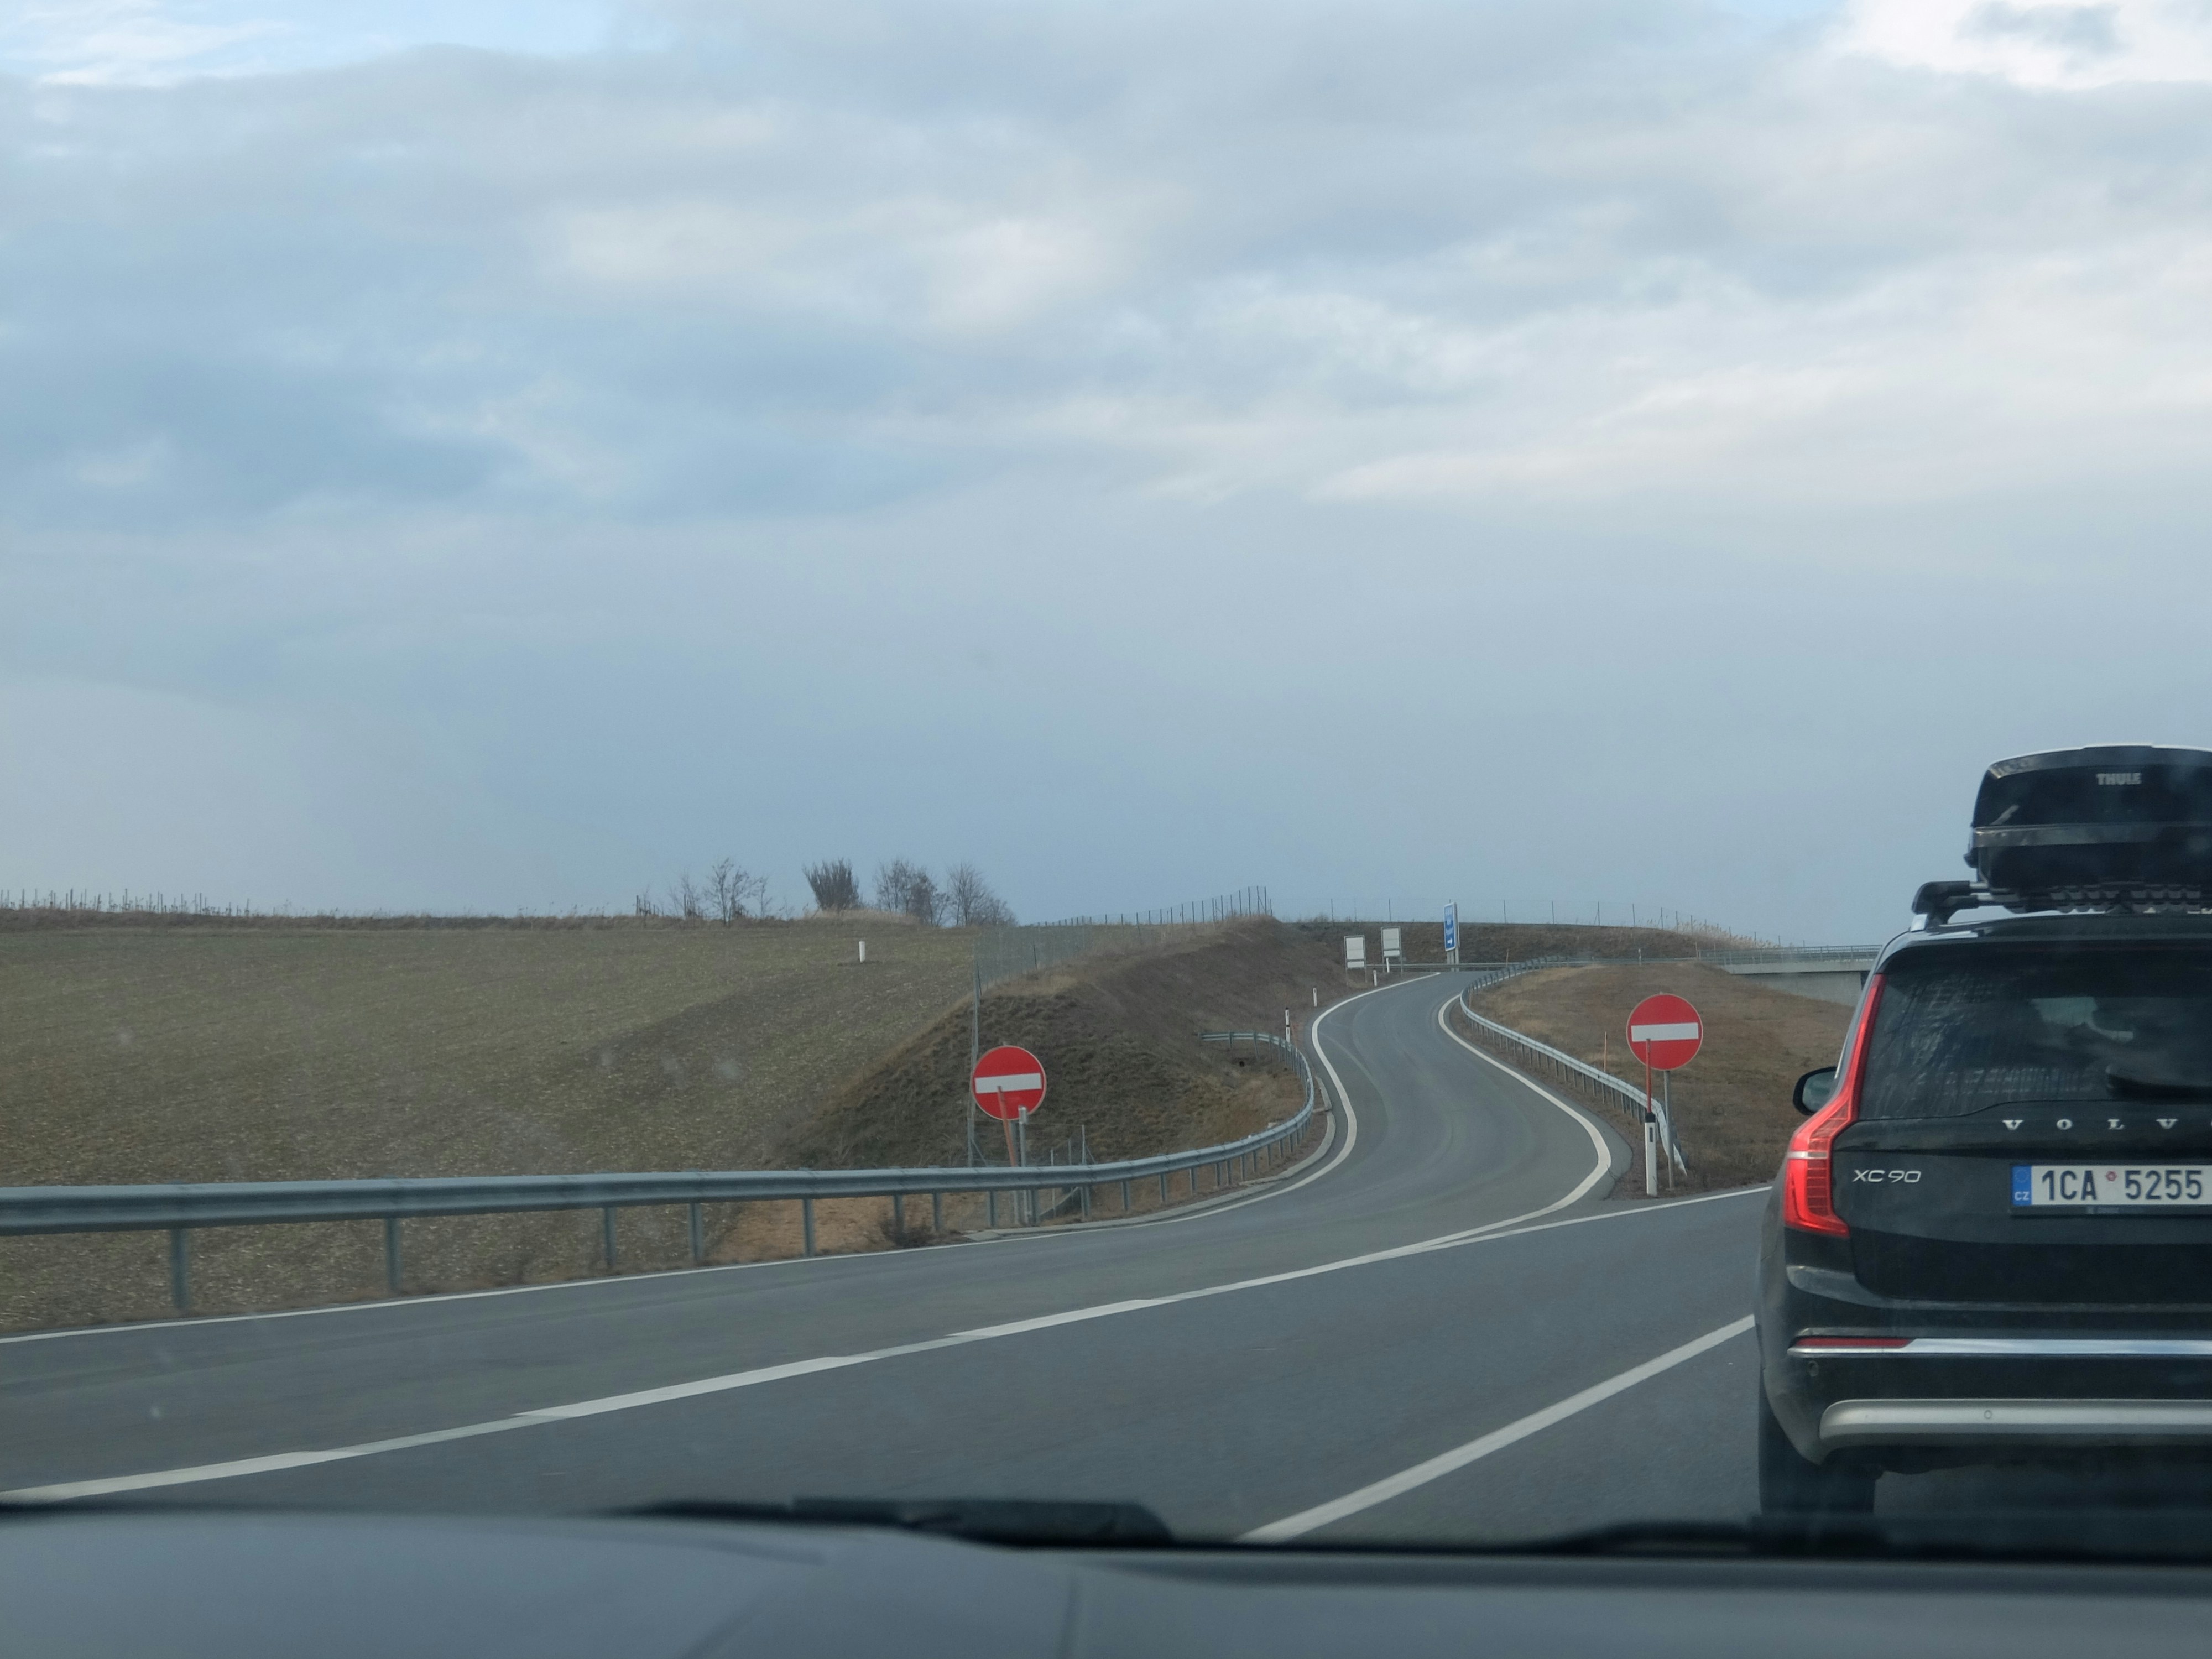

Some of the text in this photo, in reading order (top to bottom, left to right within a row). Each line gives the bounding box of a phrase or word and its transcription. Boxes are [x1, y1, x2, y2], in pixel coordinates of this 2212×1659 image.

[2096, 773, 2142, 785] THULE
[2002, 1118, 2212, 1130] VOLV
[2042, 1169, 2203, 1201] 1CA 5255
[2014, 1191, 2030, 1201] CZ
